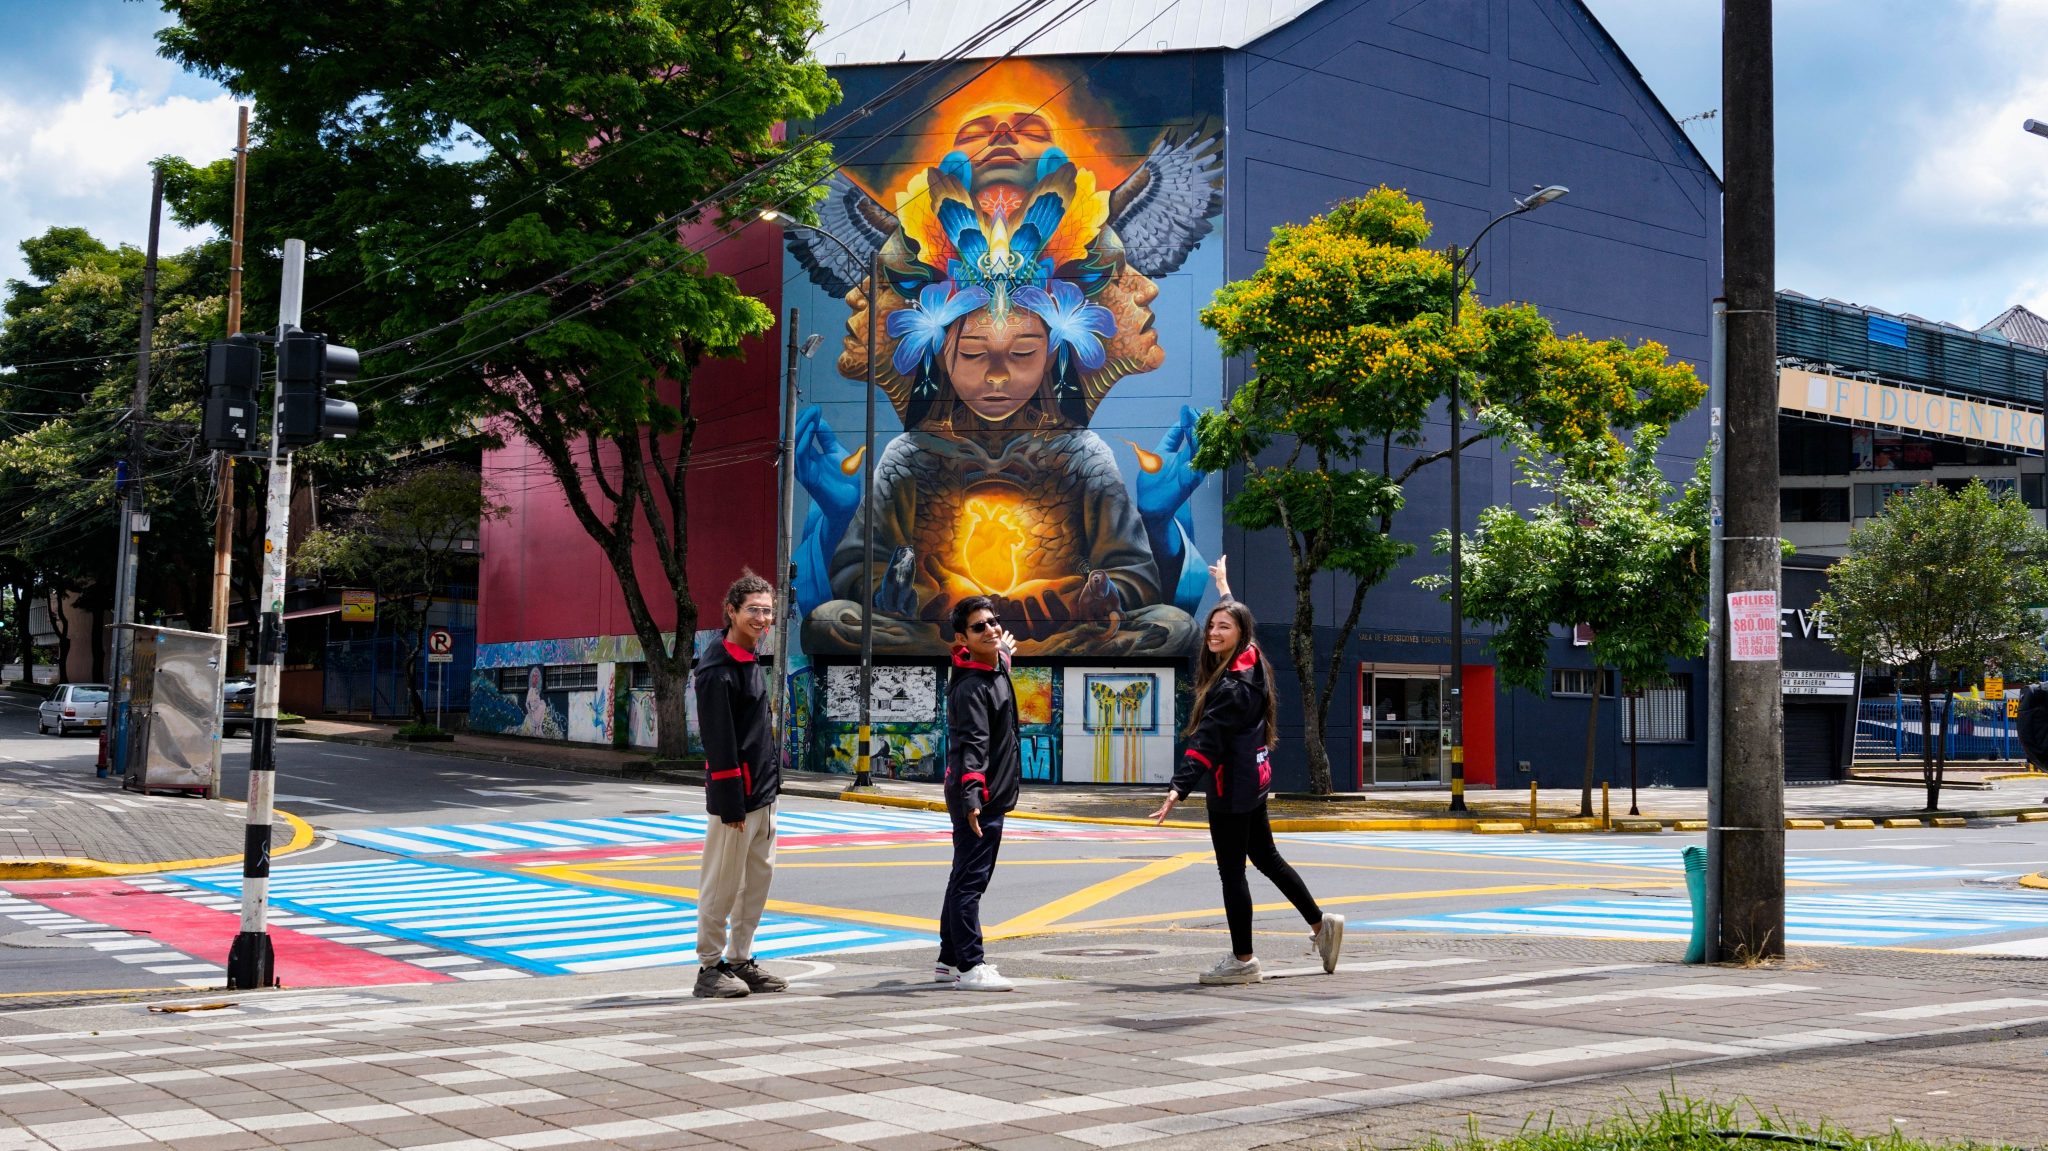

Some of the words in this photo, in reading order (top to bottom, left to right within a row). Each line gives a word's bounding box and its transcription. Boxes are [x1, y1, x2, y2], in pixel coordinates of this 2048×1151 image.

[1834, 380, 2044, 446] FIDUCENTRO
[1734, 618, 1776, 631] $80.000
[1801, 671, 1841, 679] SENTIMENTAL
